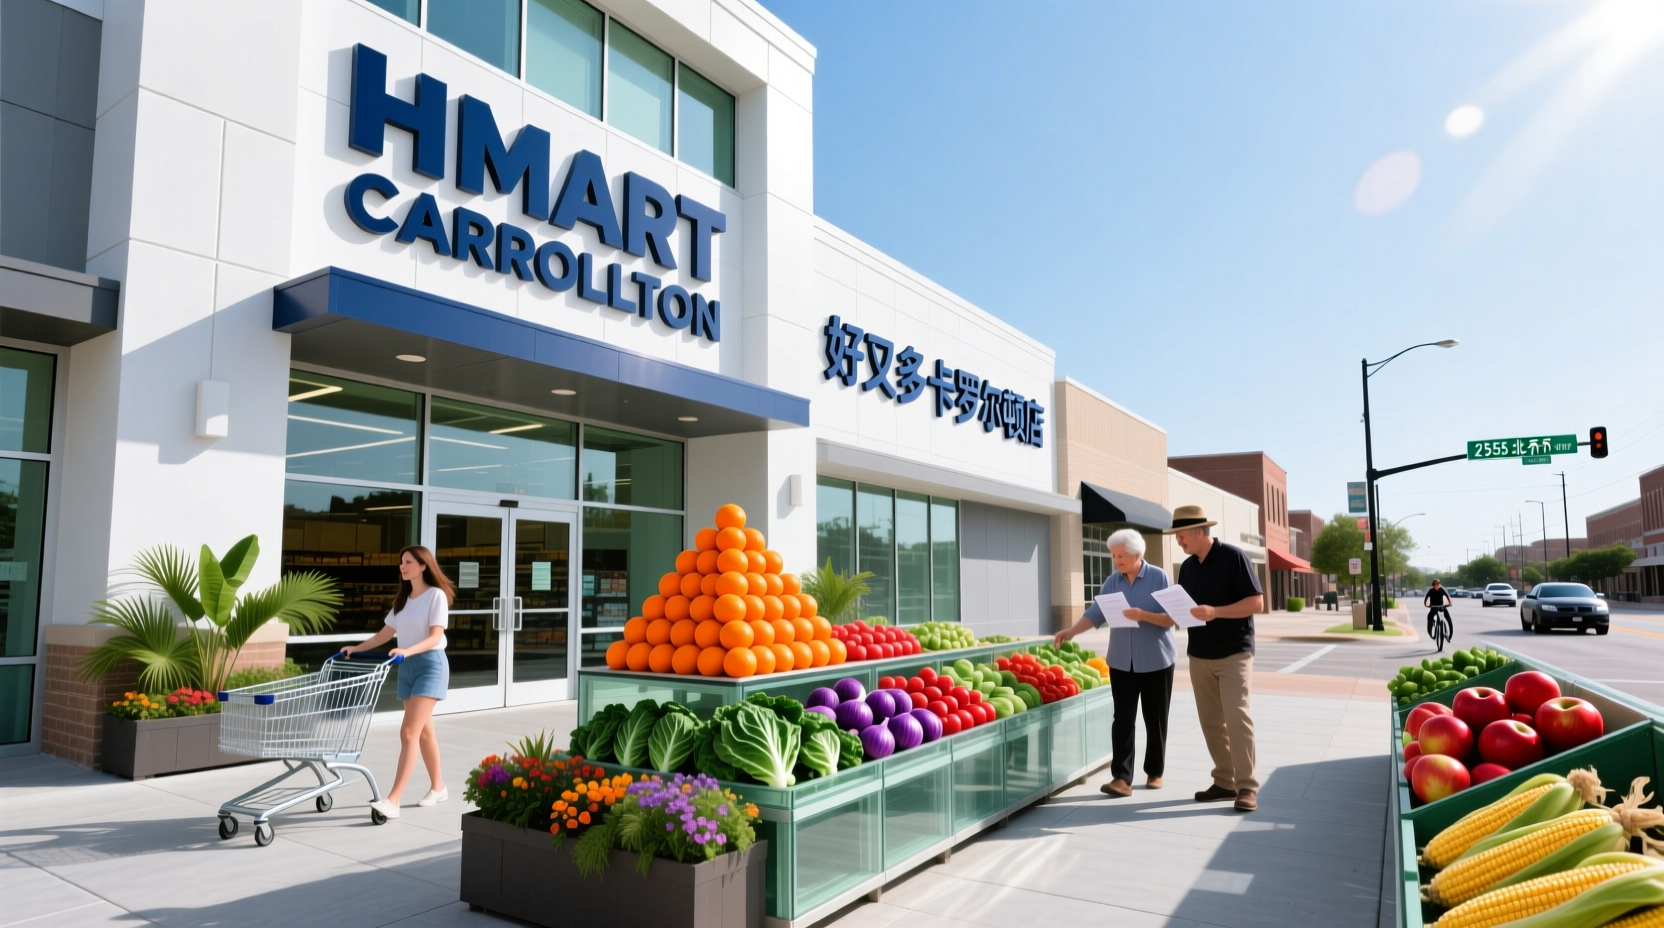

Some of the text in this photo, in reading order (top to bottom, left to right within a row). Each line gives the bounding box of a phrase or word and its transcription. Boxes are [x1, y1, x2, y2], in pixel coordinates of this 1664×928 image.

[348, 42, 727, 282] HMART
[344, 173, 721, 342] CARROLLTON
[823, 314, 1045, 448] 好又多卡罗尔顿店
[1474, 441, 1509, 457] 2555
